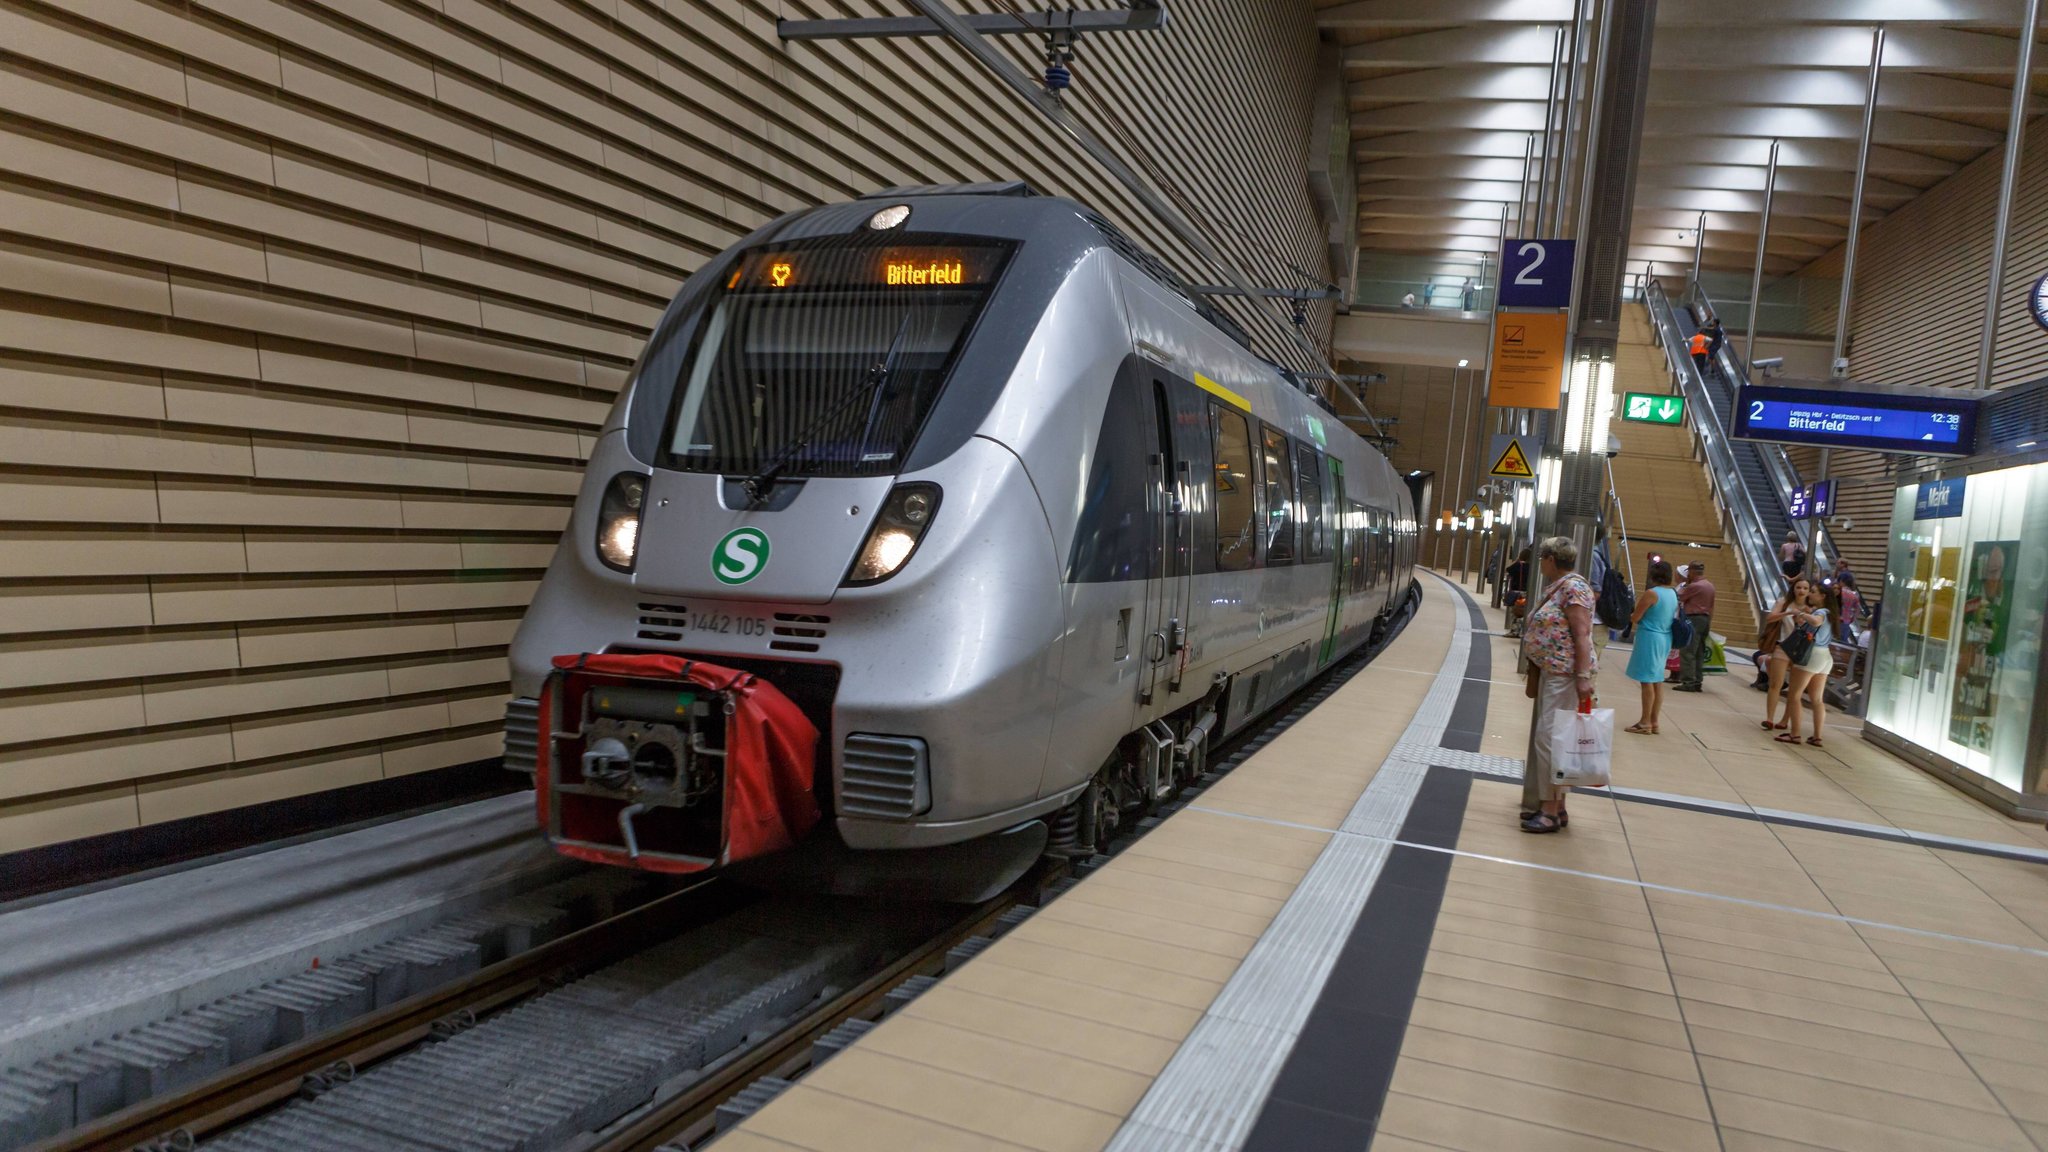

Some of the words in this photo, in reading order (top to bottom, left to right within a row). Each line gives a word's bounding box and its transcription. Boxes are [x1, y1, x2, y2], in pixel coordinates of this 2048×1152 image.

[887, 263, 962, 285] Bitterfeld
[1514, 242, 1546, 285] 2
[1750, 401, 1765, 421] 2
[1790, 410, 1811, 419] Leipzig
[1931, 413, 1960, 424] 12:38
[1788, 417, 1846, 431] Bitterfeld
[719, 533, 762, 579] S
[689, 612, 730, 634] 1442
[736, 616, 766, 637] 105
